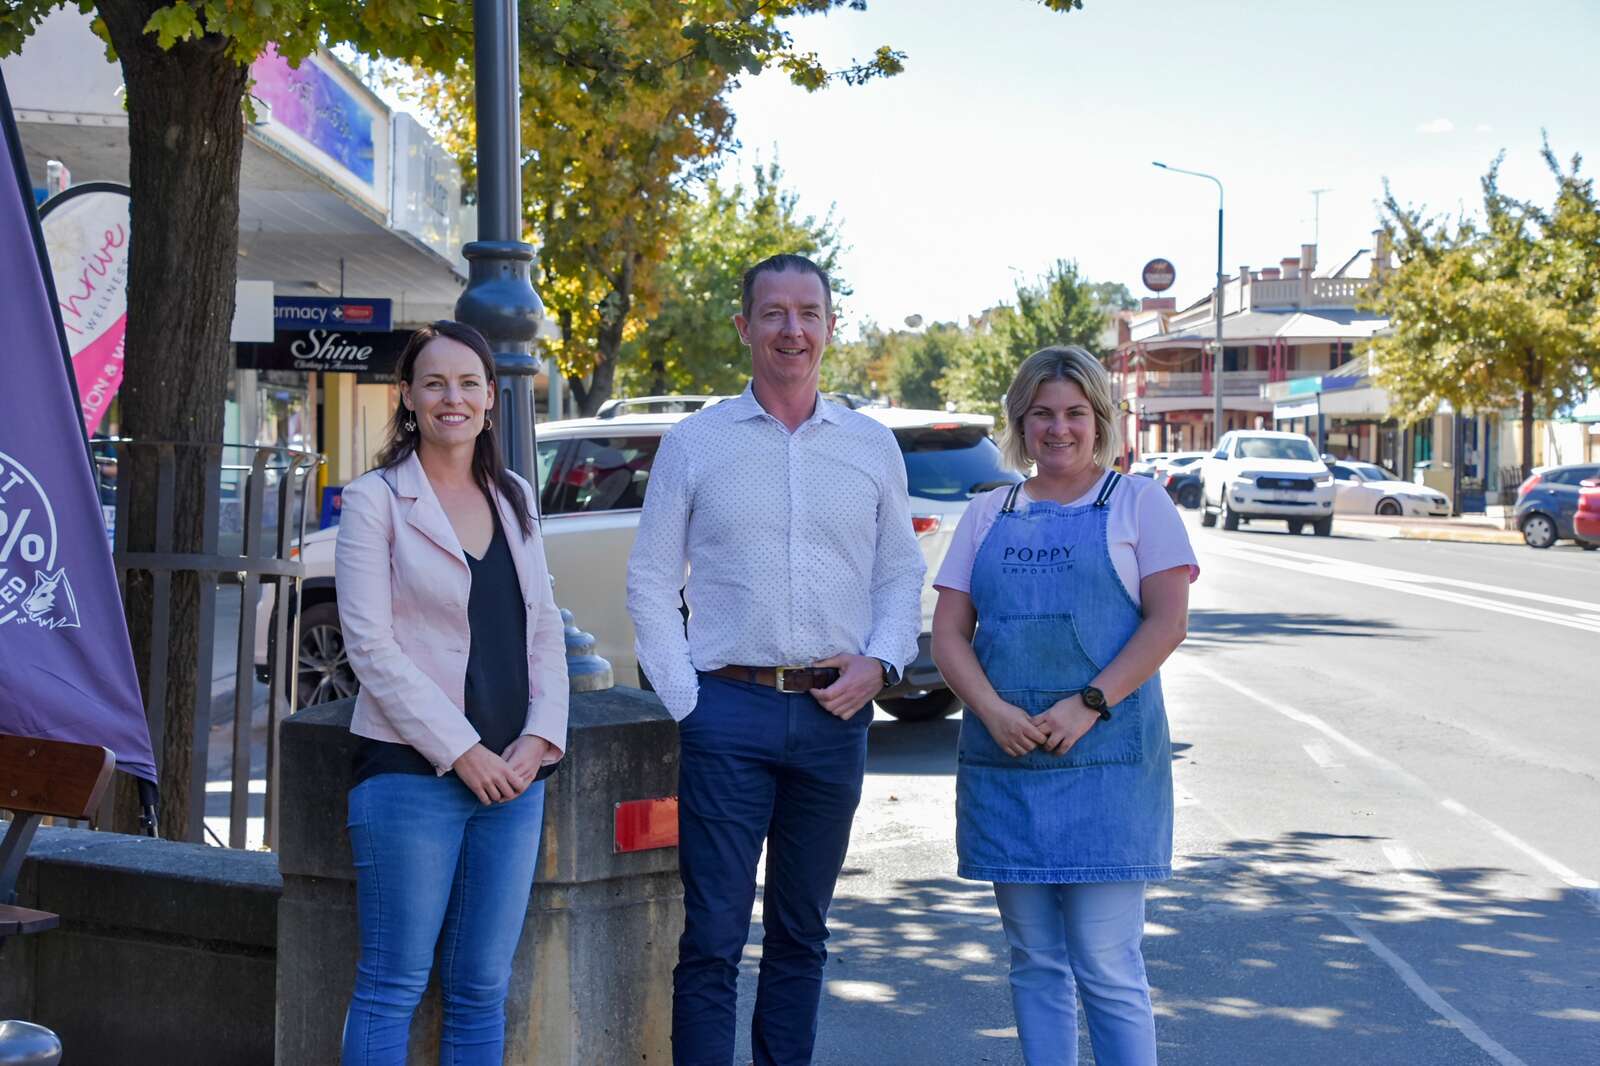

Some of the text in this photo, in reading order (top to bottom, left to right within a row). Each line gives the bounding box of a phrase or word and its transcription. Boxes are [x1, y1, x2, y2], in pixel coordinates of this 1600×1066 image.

[290, 328, 373, 361] Shine
[104, 364, 118, 377] &
[1003, 545, 1075, 562] POPPY
